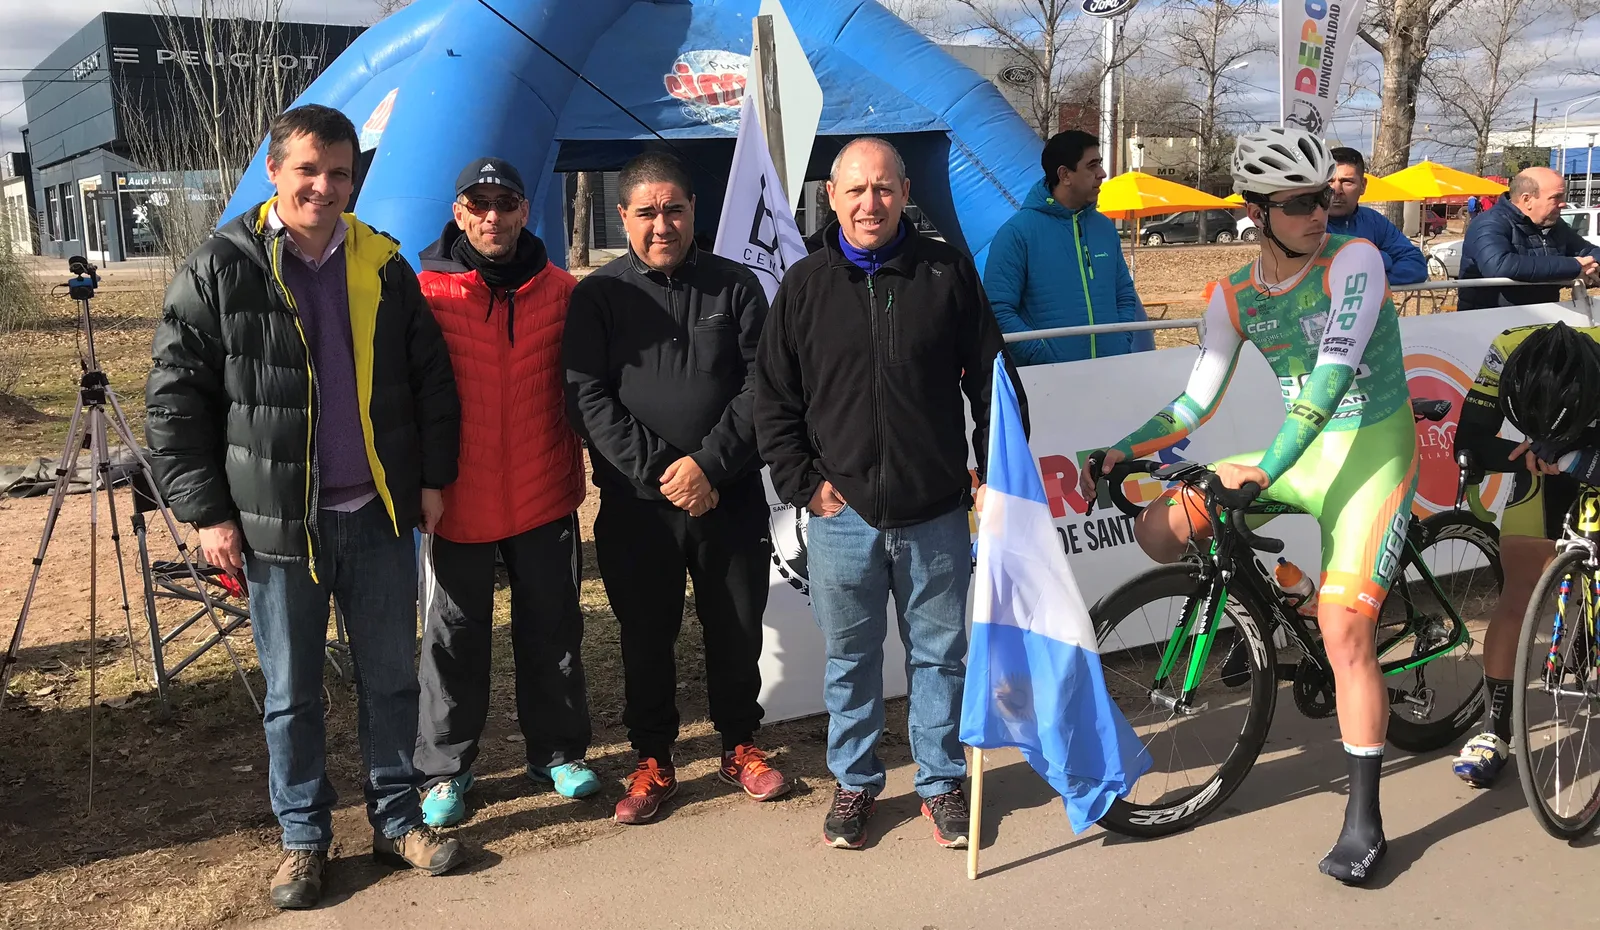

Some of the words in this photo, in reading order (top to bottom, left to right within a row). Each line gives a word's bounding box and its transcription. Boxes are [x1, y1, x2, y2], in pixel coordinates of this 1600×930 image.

[156, 49, 319, 70] PEUGEOT
[1294, 0, 1328, 95] DEPO
[1318, 4, 1341, 99] MUNICIPALIDAD
[1335, 272, 1368, 331] SEP
[1341, 394, 1367, 406] AN
[772, 504, 794, 513] SANTA
[1056, 523, 1083, 555] DE
[1083, 515, 1135, 551] SANT
[1377, 512, 1409, 579] SEP
[1489, 684, 1508, 720] ZETTS
[1128, 775, 1223, 826] ZIPP
